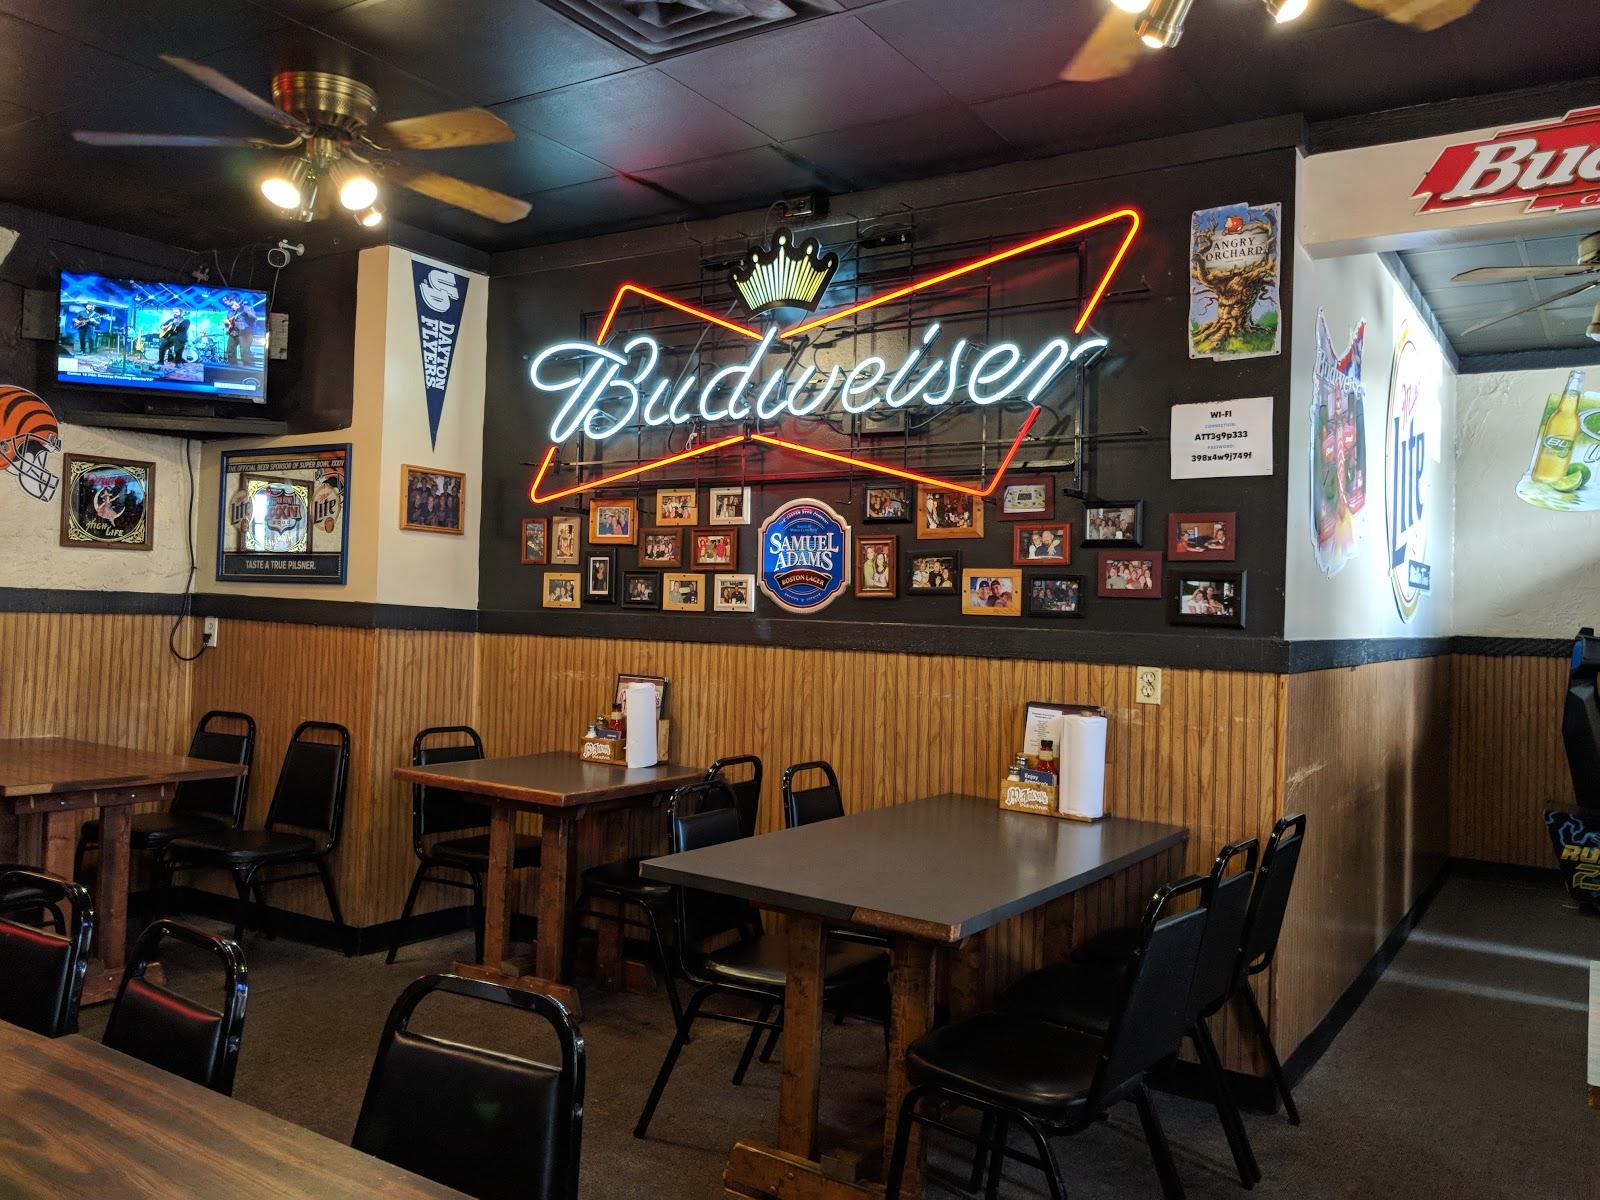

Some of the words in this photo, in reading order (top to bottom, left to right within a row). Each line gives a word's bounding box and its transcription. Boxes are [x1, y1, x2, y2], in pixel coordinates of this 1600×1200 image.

[1213, 236, 1256, 251] ANGRY
[1205, 245, 1264, 262] ORCHARD
[421, 315, 439, 389] FLYERS
[435, 320, 455, 391] DAYTON
[529, 323, 1111, 444] Budweiser
[1194, 430, 1248, 441] ATT3g9p333
[256, 463, 270, 471] BEER
[300, 461, 316, 469] SUPER
[769, 532, 840, 554] SAMUEL
[245, 560, 264, 569] TASTE
[265, 560, 270, 569] A
[271, 560, 287, 569] TRUE
[773, 551, 834, 572] ADAMS
[781, 574, 805, 586] BOSTON
[805, 575, 825, 586] LAGER
[1560, 844, 1600, 864] RU
